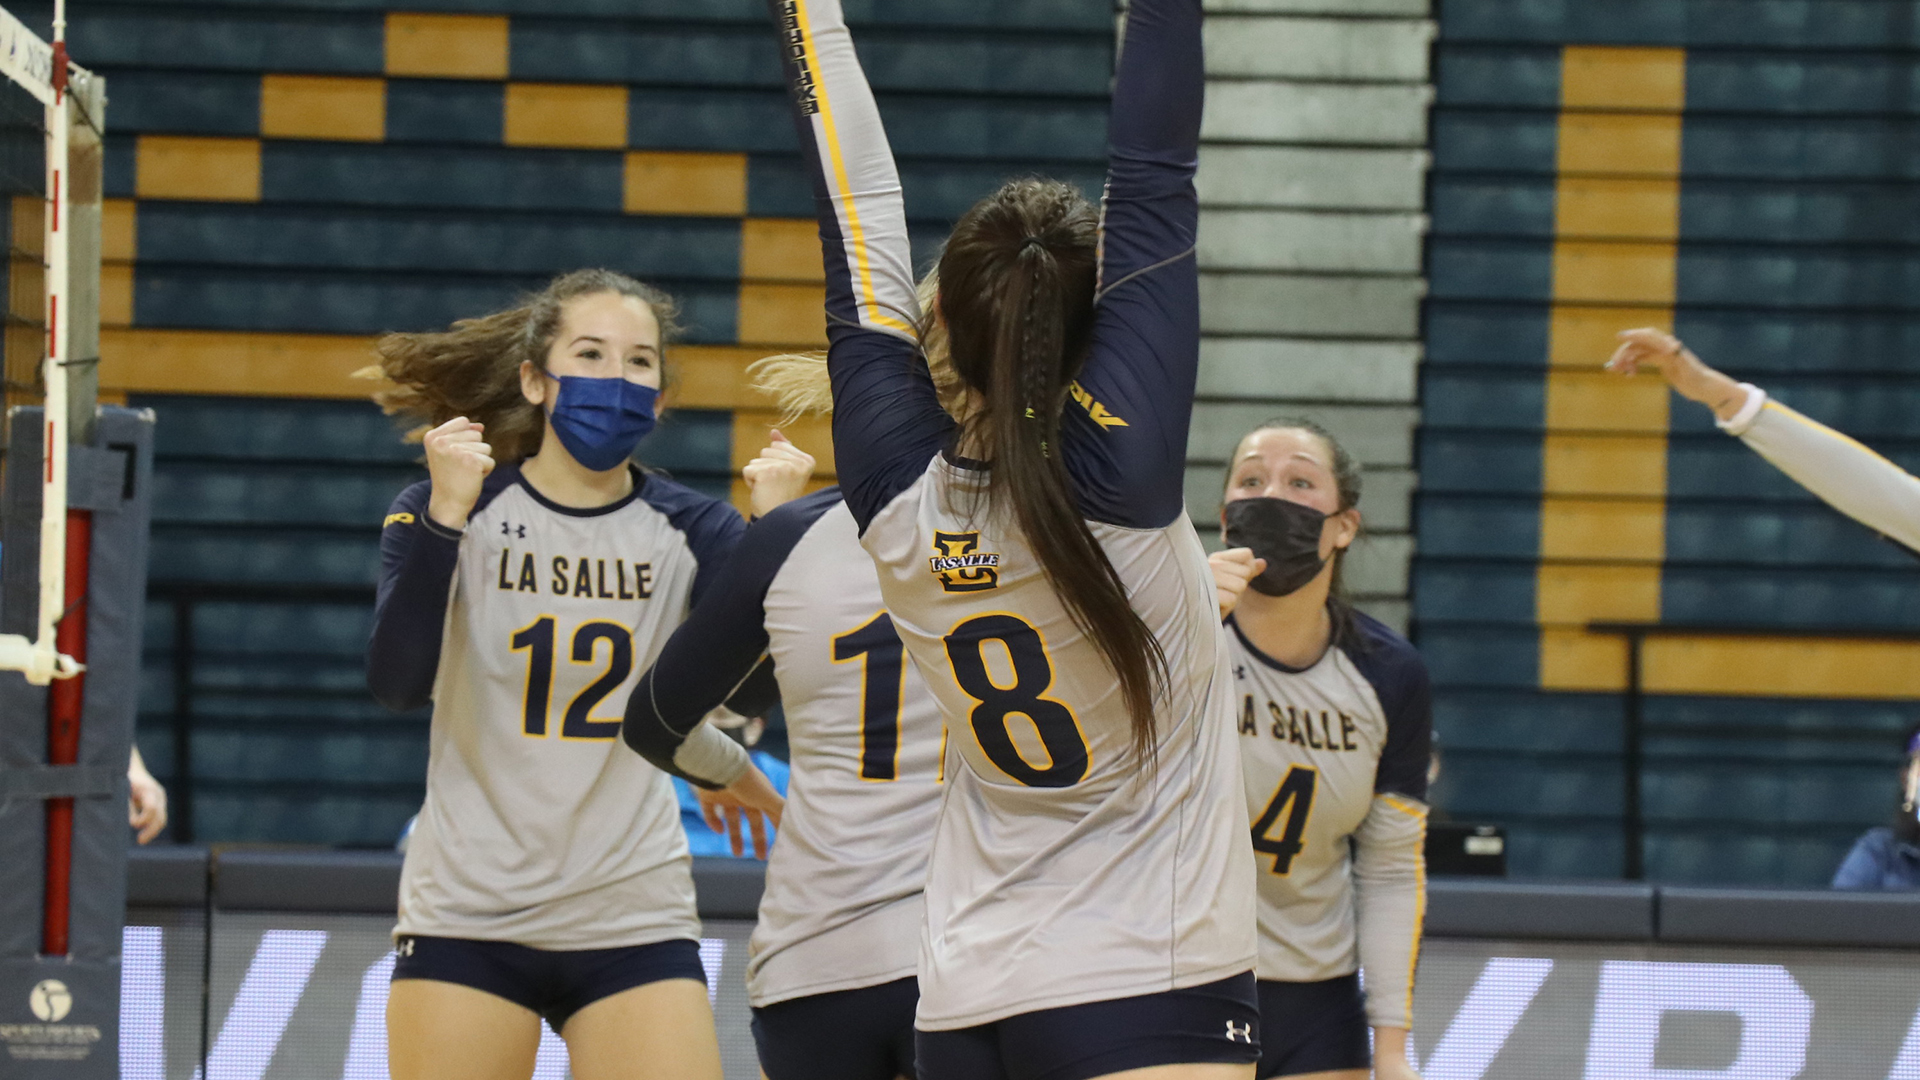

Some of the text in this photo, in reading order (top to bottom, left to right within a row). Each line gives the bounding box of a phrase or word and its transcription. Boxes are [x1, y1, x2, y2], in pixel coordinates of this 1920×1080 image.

[498, 547, 653, 600] LA SALLE
[508, 613, 635, 743] 12
[830, 609, 944, 784] 1
[943, 610, 1093, 788] 8
[1236, 694, 1358, 751] A SALLE
[1250, 762, 1320, 878] 4
